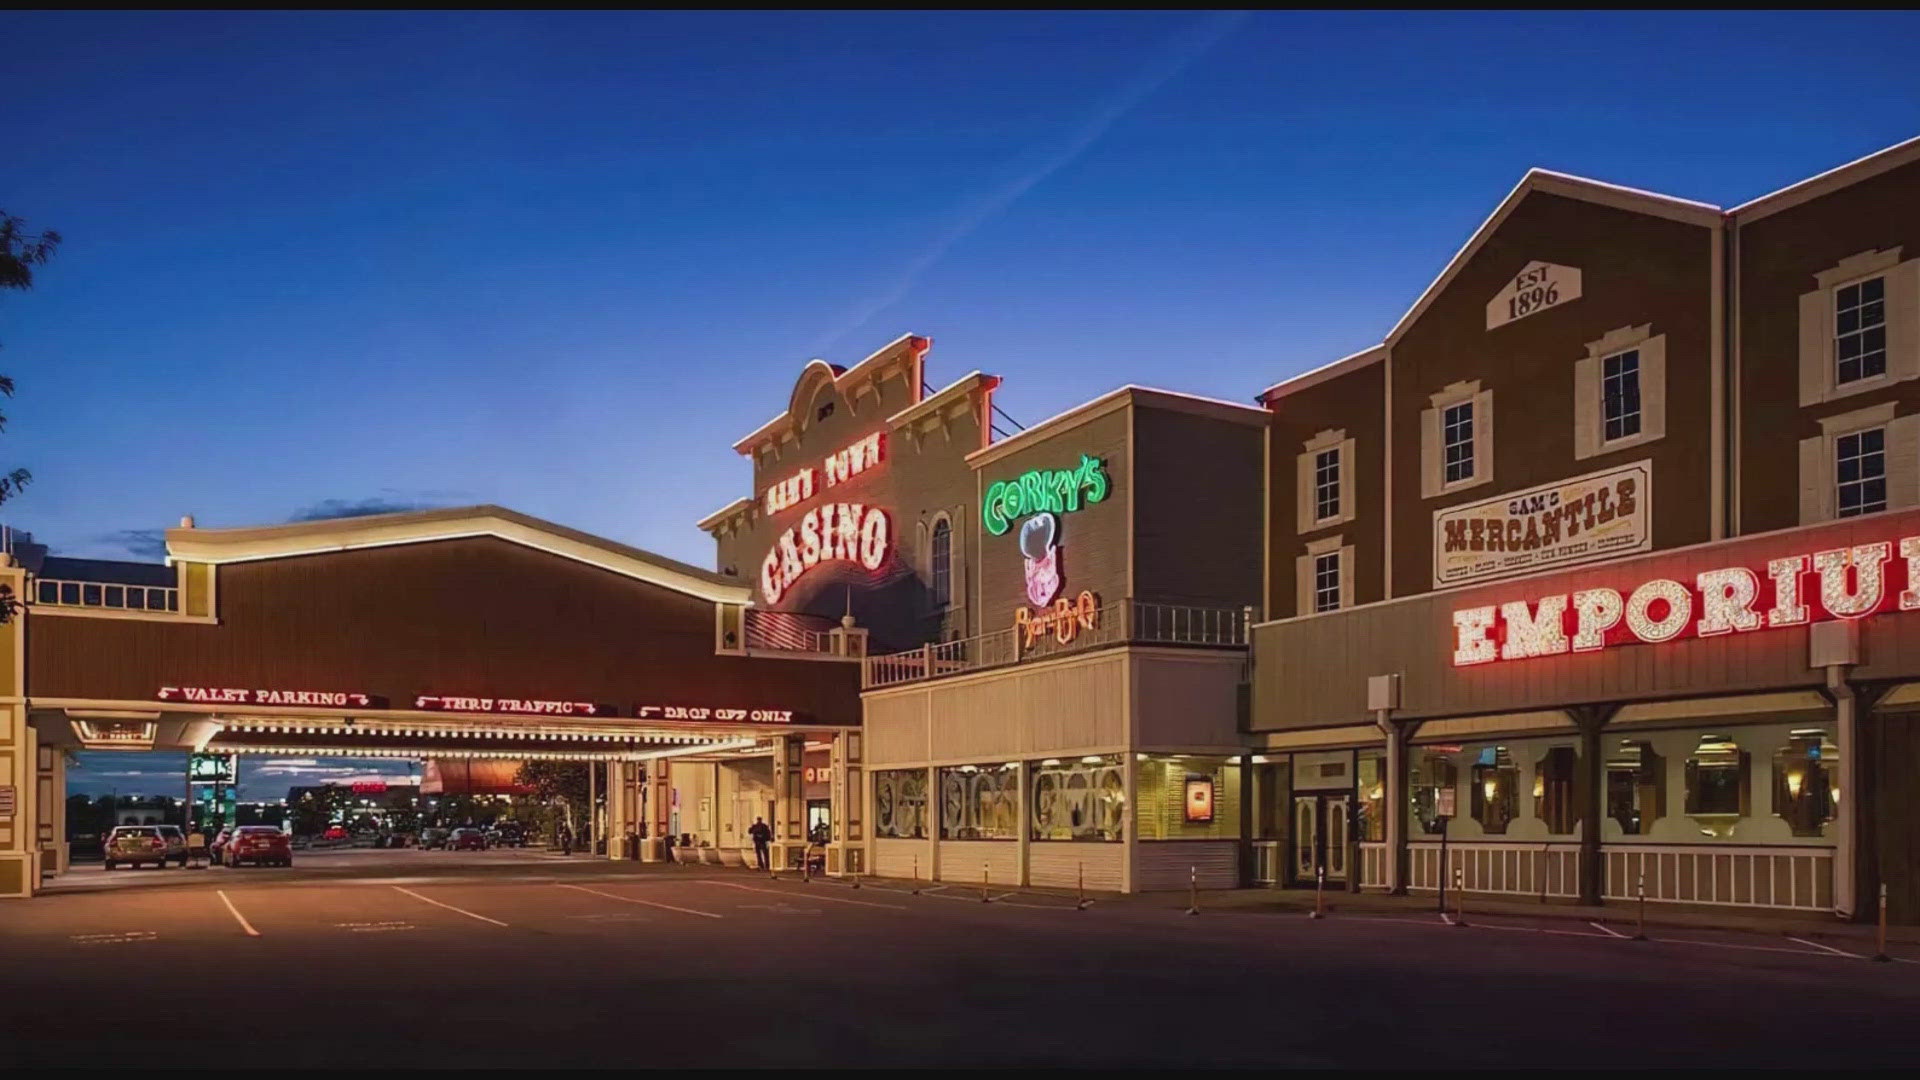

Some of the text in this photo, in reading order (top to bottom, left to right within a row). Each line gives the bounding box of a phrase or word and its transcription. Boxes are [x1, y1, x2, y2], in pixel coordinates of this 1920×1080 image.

[1515, 265, 1550, 292] EST
[1509, 281, 1558, 319] 1896
[825, 432, 881, 488] TOWN
[984, 454, 1107, 536] CORKY'S
[1508, 491, 1560, 516] SAM'S
[1444, 477, 1637, 553] MERCANTILE
[762, 503, 888, 605] CASINO
[182, 687, 347, 705] VALET PARKING
[441, 696, 573, 713] THRU TRAFFIC
[665, 707, 792, 722] DROP OFF ONLY
